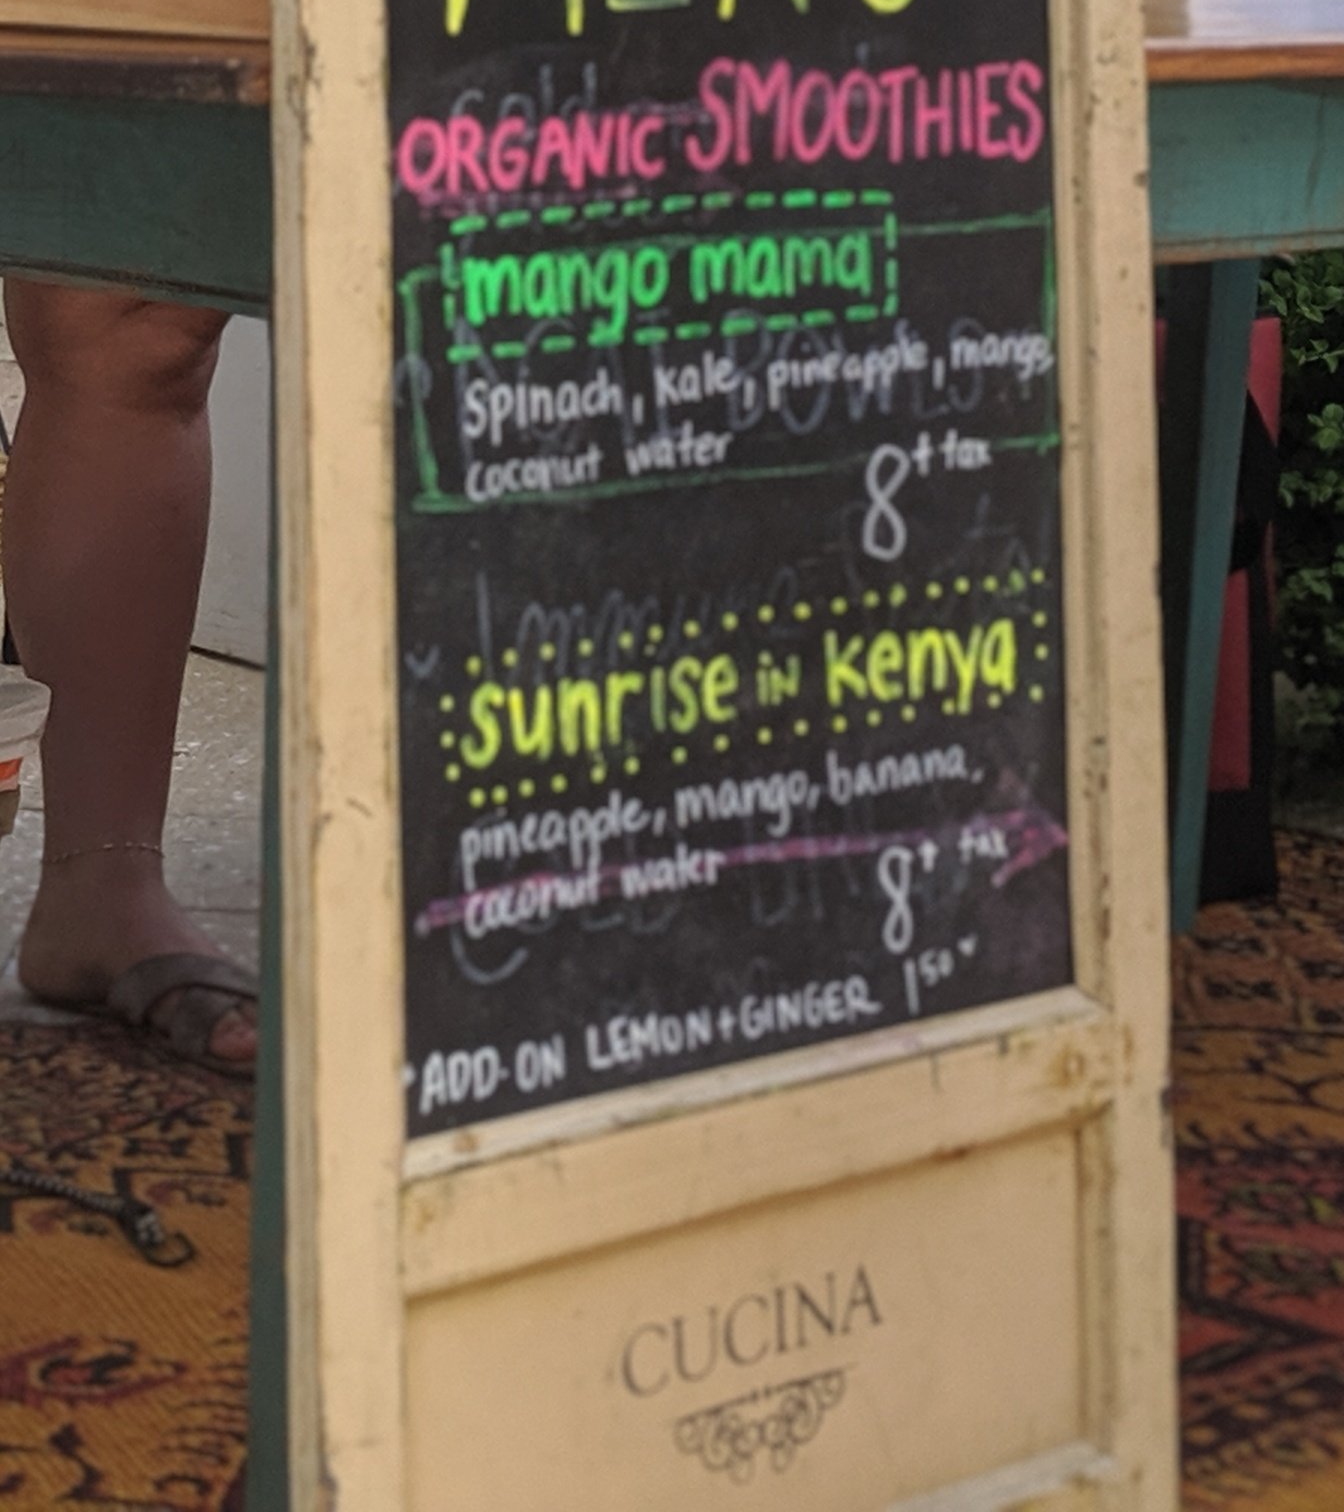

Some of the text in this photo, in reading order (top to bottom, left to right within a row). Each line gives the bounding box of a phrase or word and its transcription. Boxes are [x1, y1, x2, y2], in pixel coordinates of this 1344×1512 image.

[397, 58, 1045, 194] ORGANIC SMOOTHIES
[461, 230, 872, 344] mango mama
[464, 419, 735, 503] coconut water
[621, 1264, 882, 1398] CUCINA
